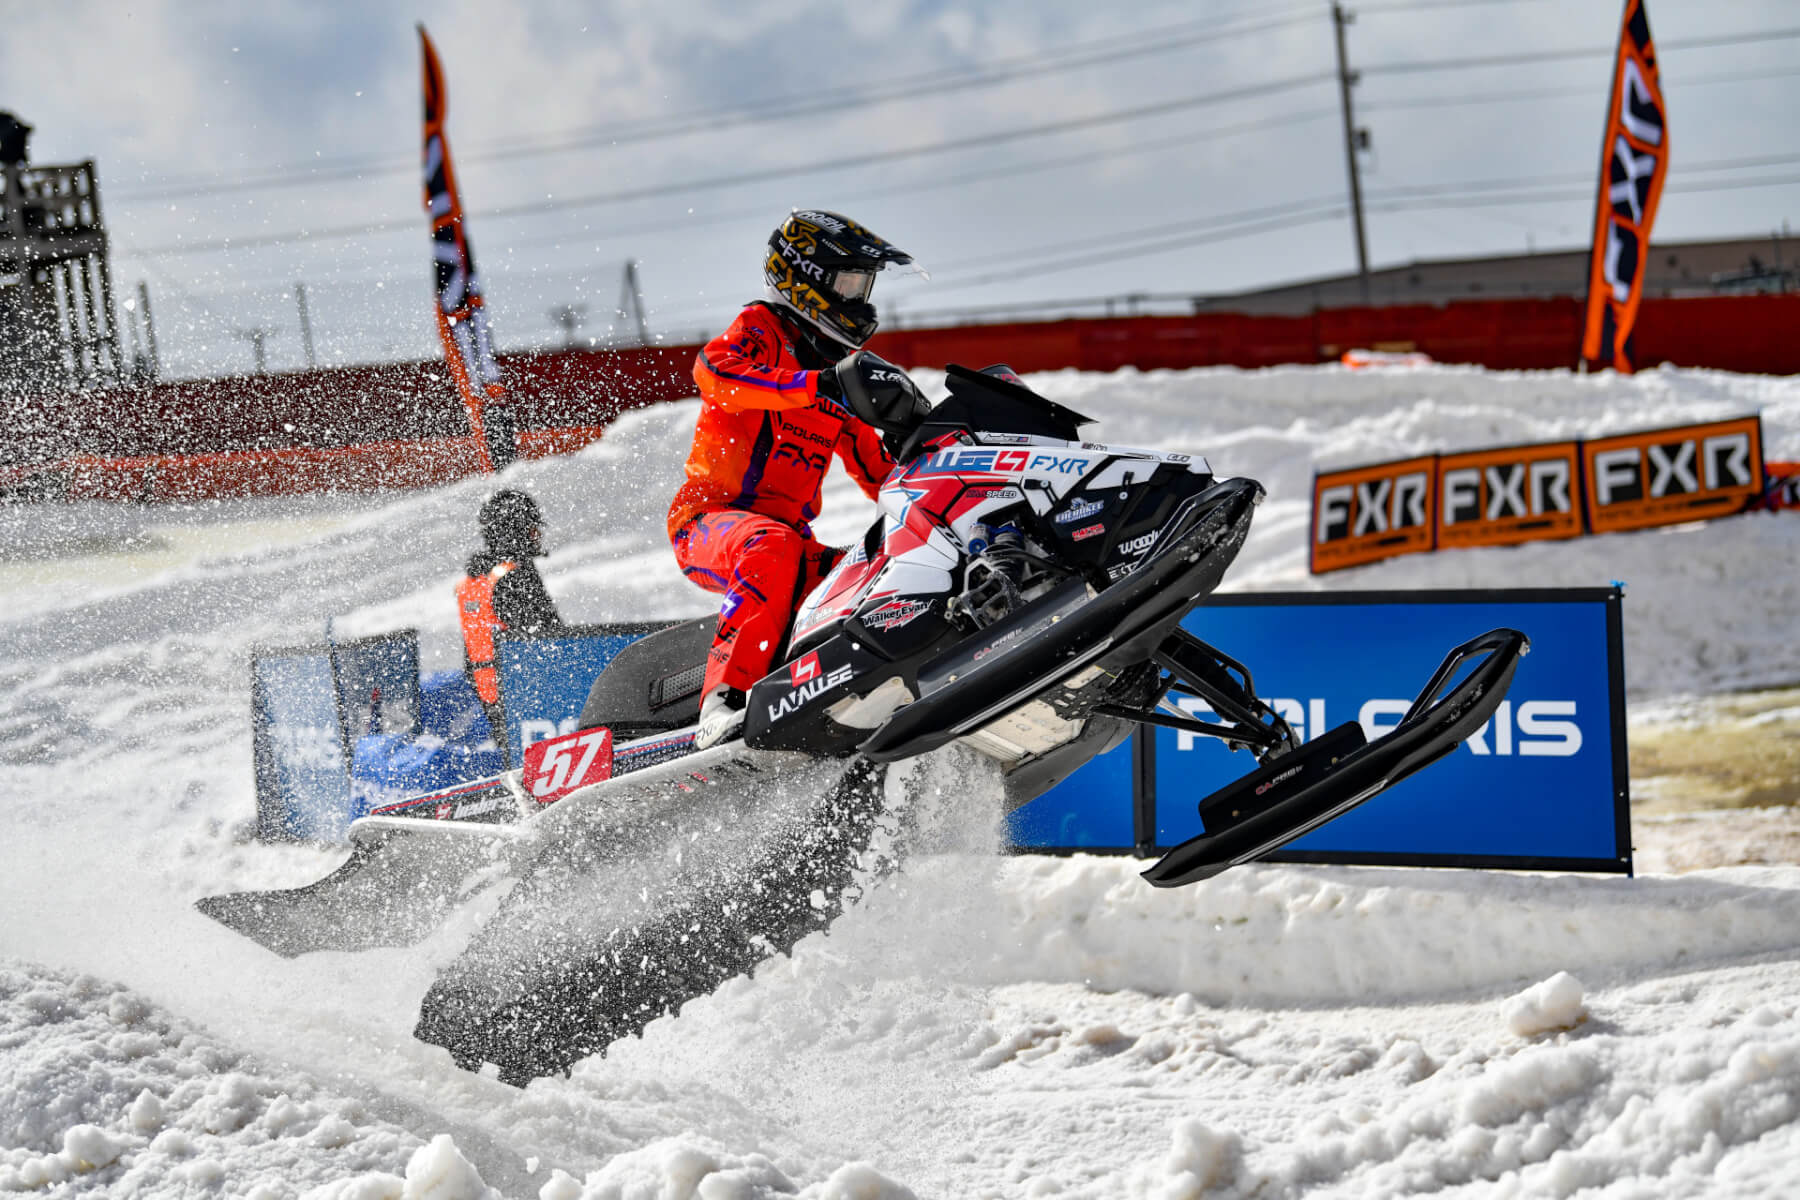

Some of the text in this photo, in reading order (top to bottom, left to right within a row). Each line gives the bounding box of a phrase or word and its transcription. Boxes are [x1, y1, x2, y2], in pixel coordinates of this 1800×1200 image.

[766, 252, 831, 321] FXR
[783, 244, 825, 281] FXR
[1030, 455, 1090, 476] FXR
[1442, 460, 1572, 526] FXR
[1594, 431, 1753, 507] FXR
[1317, 475, 1428, 544] FXR
[901, 602, 930, 614] Evan
[1177, 698, 1584, 757] PLAIS
[532, 730, 607, 797] 57
